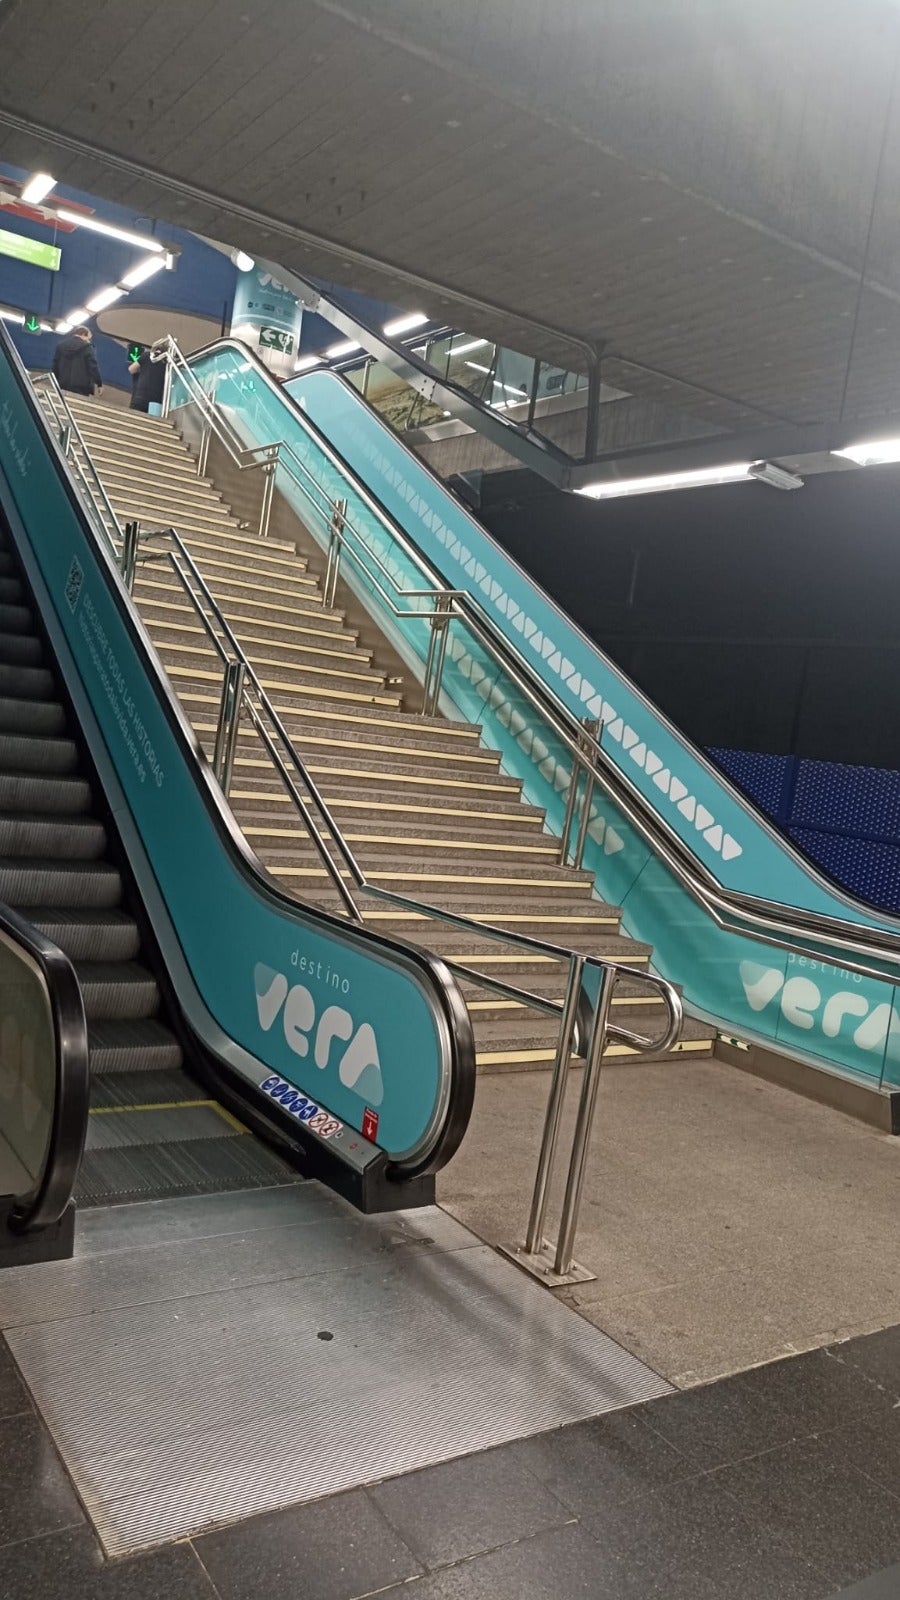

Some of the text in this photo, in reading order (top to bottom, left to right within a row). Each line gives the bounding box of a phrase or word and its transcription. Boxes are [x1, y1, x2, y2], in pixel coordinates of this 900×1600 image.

[106, 647, 125, 693] TODAS
[122, 687, 135, 718] LAS
[133, 712, 164, 787] HISTORIAS
[290, 949, 350, 994] destino
